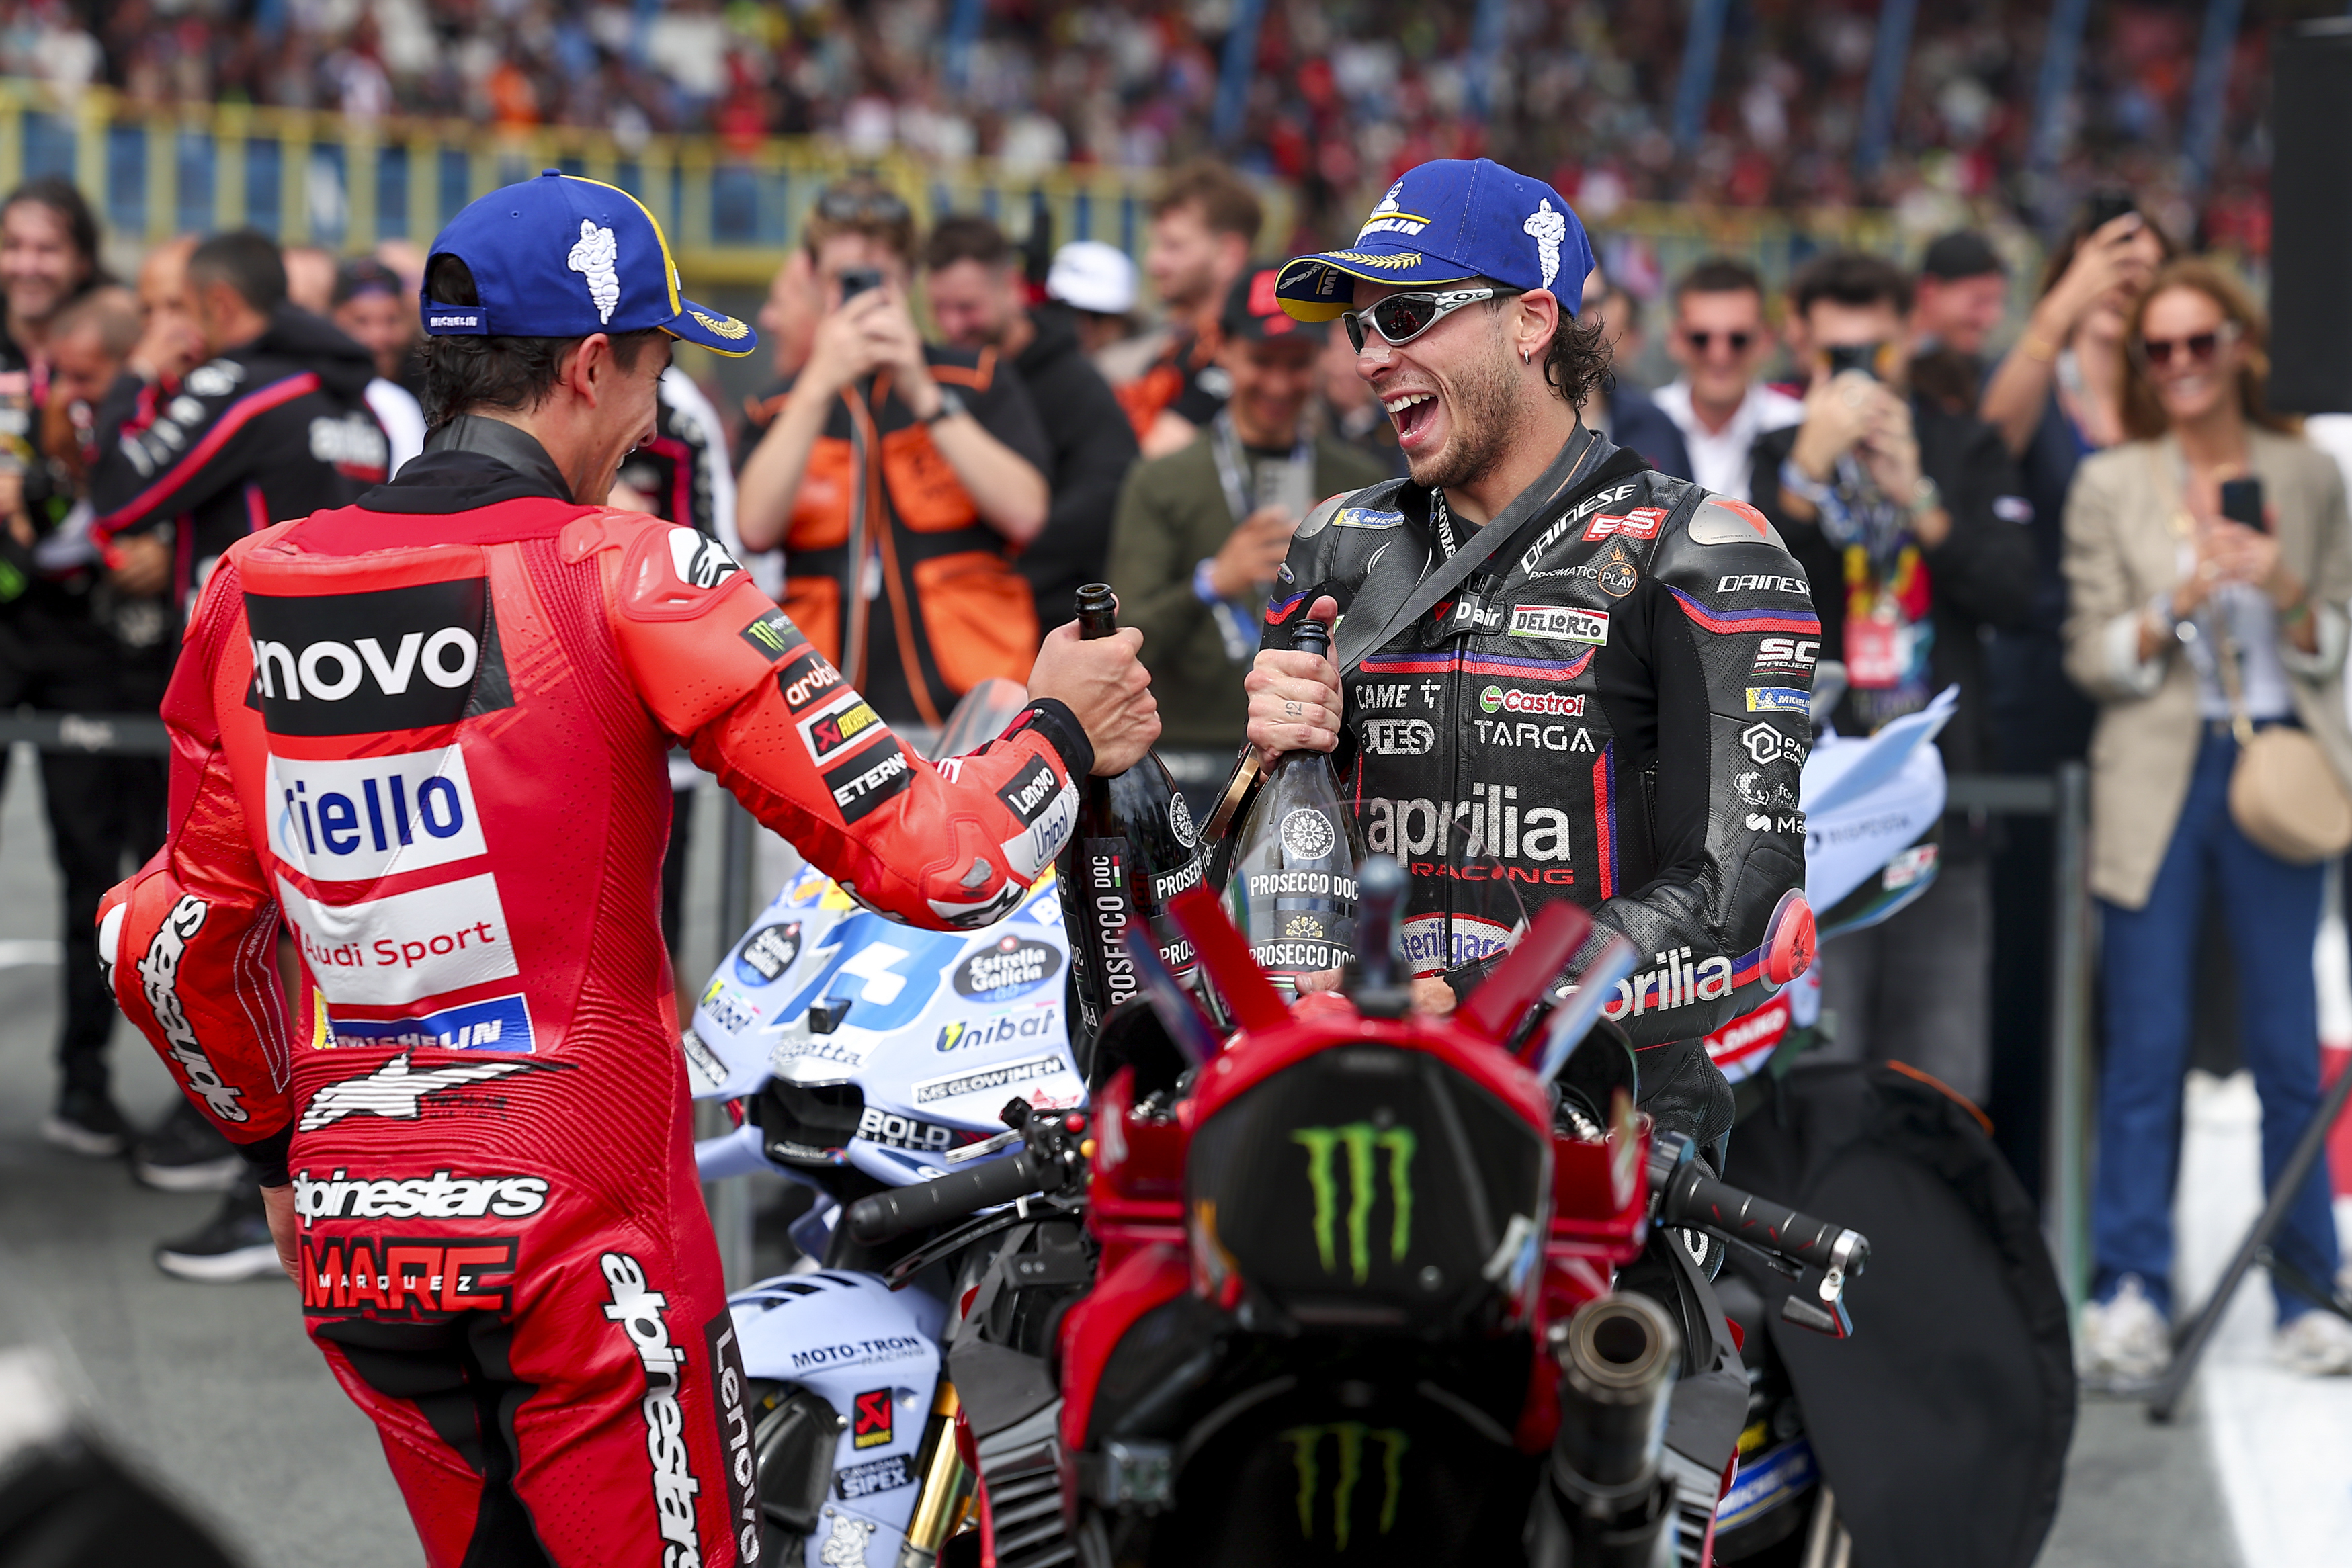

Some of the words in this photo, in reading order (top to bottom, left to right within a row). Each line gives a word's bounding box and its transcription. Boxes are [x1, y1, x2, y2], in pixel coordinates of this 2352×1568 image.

[429, 316, 478, 328] MICHELIN
[1521, 484, 1637, 575] DAINESE
[1602, 572, 1635, 589] PLAY
[1753, 660, 1814, 670] PROJECT
[1755, 638, 1821, 663] SC
[1355, 684, 1411, 709] CAME
[1504, 688, 1586, 717] Castrol
[1474, 719, 1596, 753] TARGA
[1007, 767, 1055, 816] Lenovo
[1033, 799, 1068, 859] Unipol
[1368, 781, 1572, 868] aprilia
[1092, 855, 1111, 889] DOC
[1250, 873, 1329, 897] PROSECCO
[1333, 875, 1359, 901] DOC
[1411, 862, 1575, 885] RACING
[304, 937, 364, 968] Audi
[373, 920, 495, 969] Sport
[970, 947, 1047, 975] Estrella
[1096, 895, 1138, 1006] ROSECCO
[970, 965, 1044, 992] Galicia
[138, 894, 249, 1122] alpinestars
[937, 1008, 1055, 1053] Unibat
[859, 1106, 952, 1148] BOLD
[302, 1244, 509, 1311] MARC
[318, 1274, 472, 1292] MARQUEZ
[791, 1336, 919, 1368] MOTO-TRON
[716, 1325, 761, 1565] Lenovo
[842, 1468, 907, 1499] SIPEX
